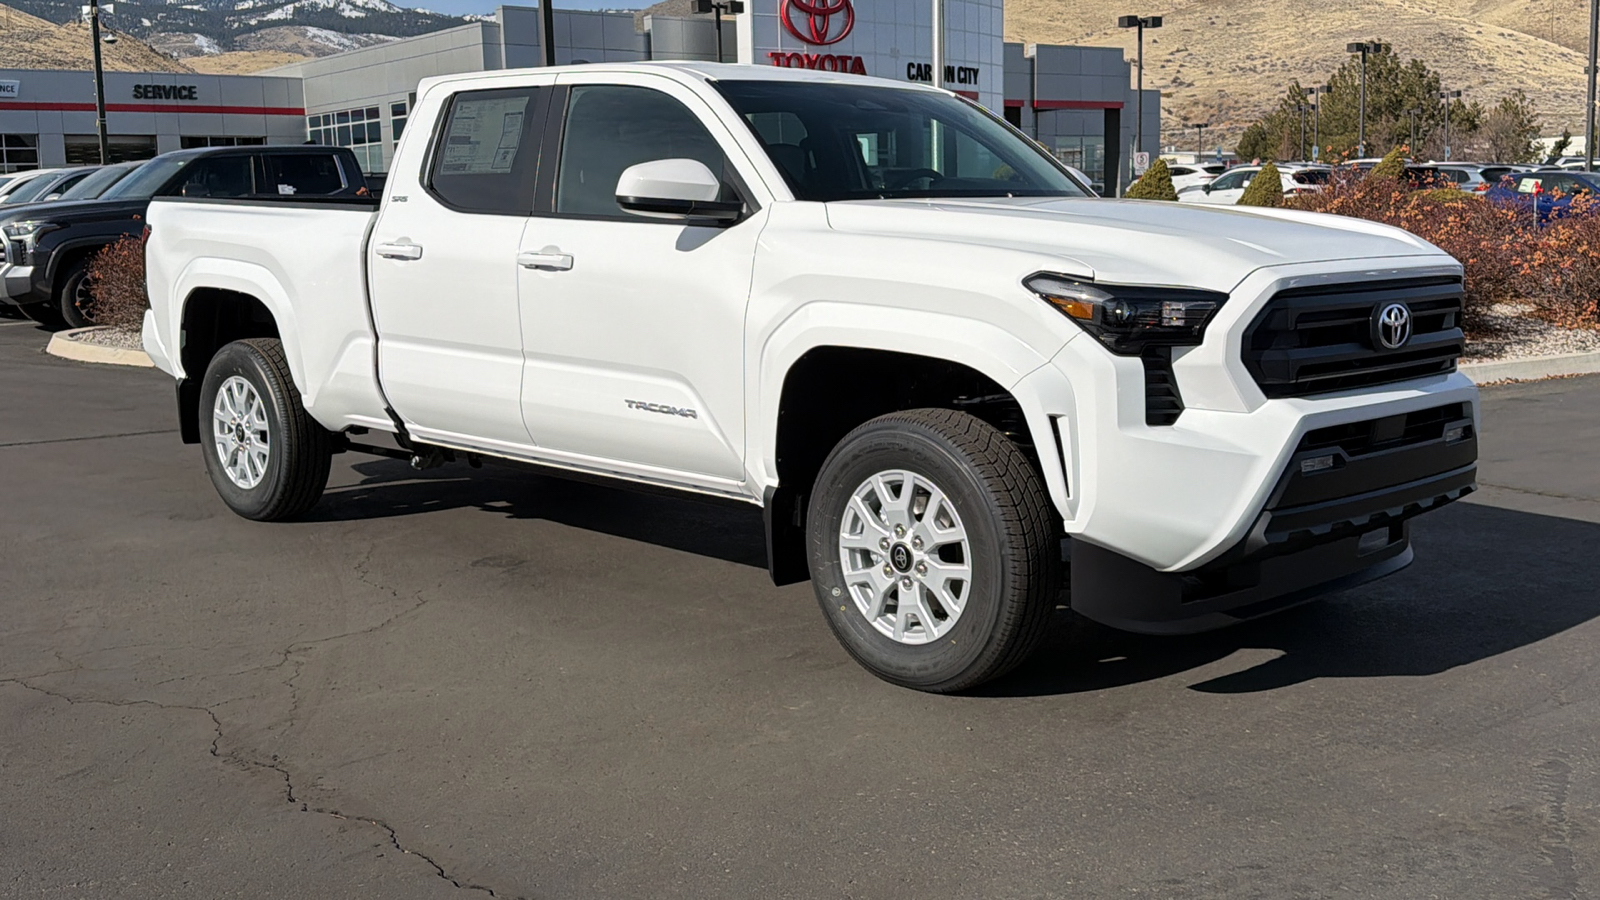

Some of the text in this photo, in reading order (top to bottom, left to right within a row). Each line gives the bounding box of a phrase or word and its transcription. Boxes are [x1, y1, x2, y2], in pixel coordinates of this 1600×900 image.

[767, 52, 867, 75] TOYOTA
[906, 62, 979, 85] CARN CITY
[132, 84, 198, 100] SERVICE
[624, 399, 698, 419] TACOMA
